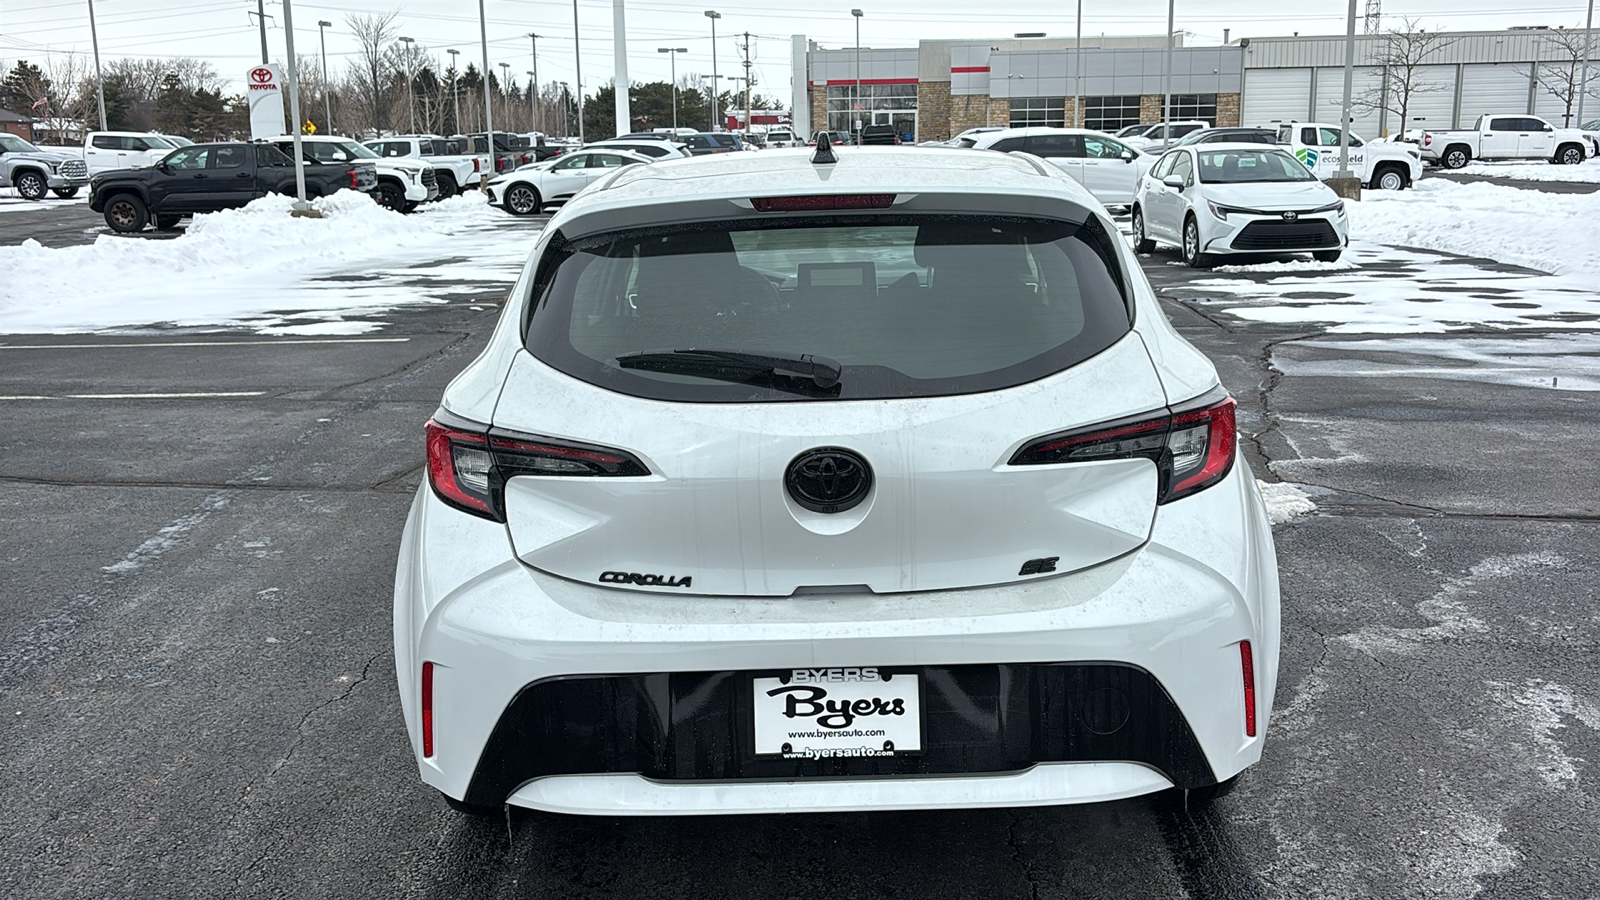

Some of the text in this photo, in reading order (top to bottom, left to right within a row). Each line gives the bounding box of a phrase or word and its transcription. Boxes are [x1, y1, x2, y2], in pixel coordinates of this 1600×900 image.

[1322, 155, 1363, 163] ecosield
[1018, 556, 1060, 576] SE
[598, 571, 692, 588] COROLLA
[791, 667, 879, 683] BYERS
[766, 685, 905, 729] Byers
[788, 728, 886, 740] www.byersauto.com
[783, 746, 895, 760] www.byersauto.com
